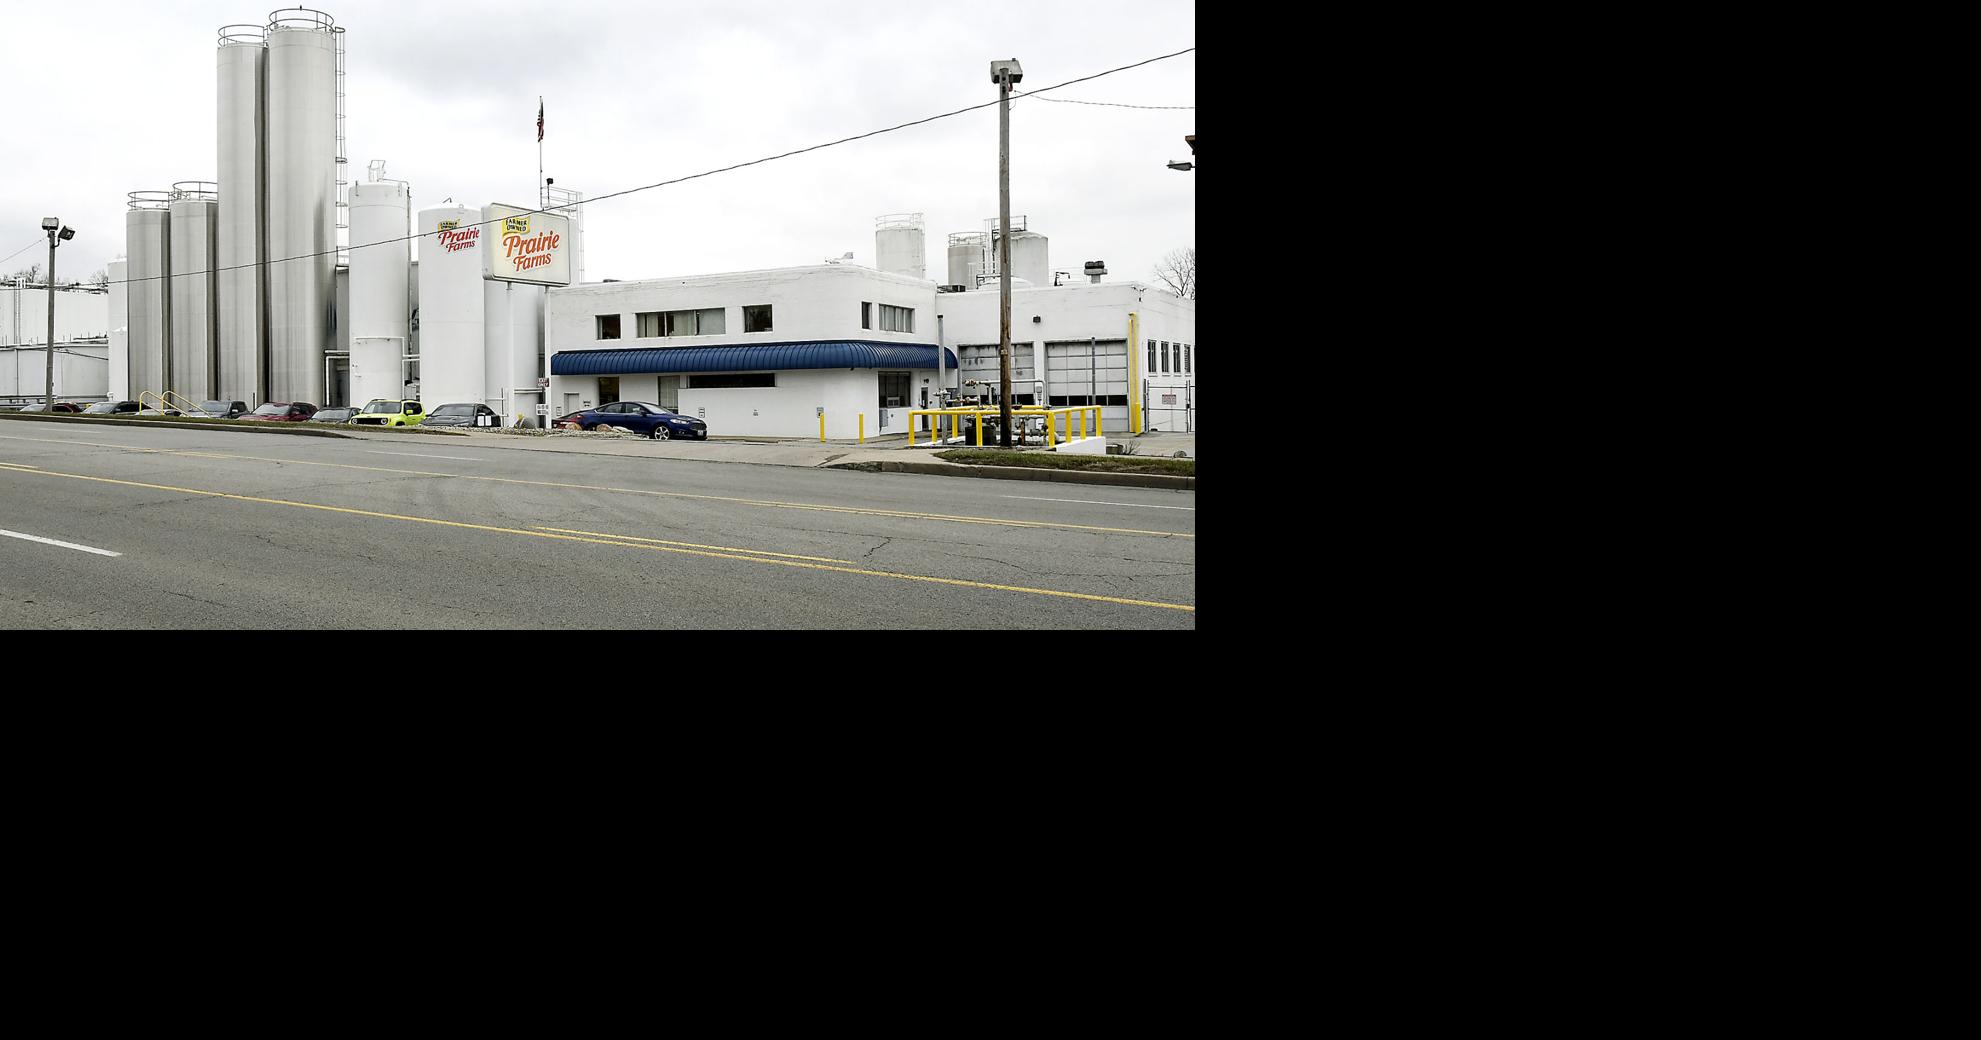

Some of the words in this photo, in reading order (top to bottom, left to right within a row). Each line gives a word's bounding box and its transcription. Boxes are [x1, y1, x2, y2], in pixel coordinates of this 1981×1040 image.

[505, 218, 527, 226] FARMER
[438, 227, 479, 245] Prairie
[503, 230, 560, 257] Prairie
[446, 240, 475, 252] Farms
[513, 253, 552, 271] Farms
